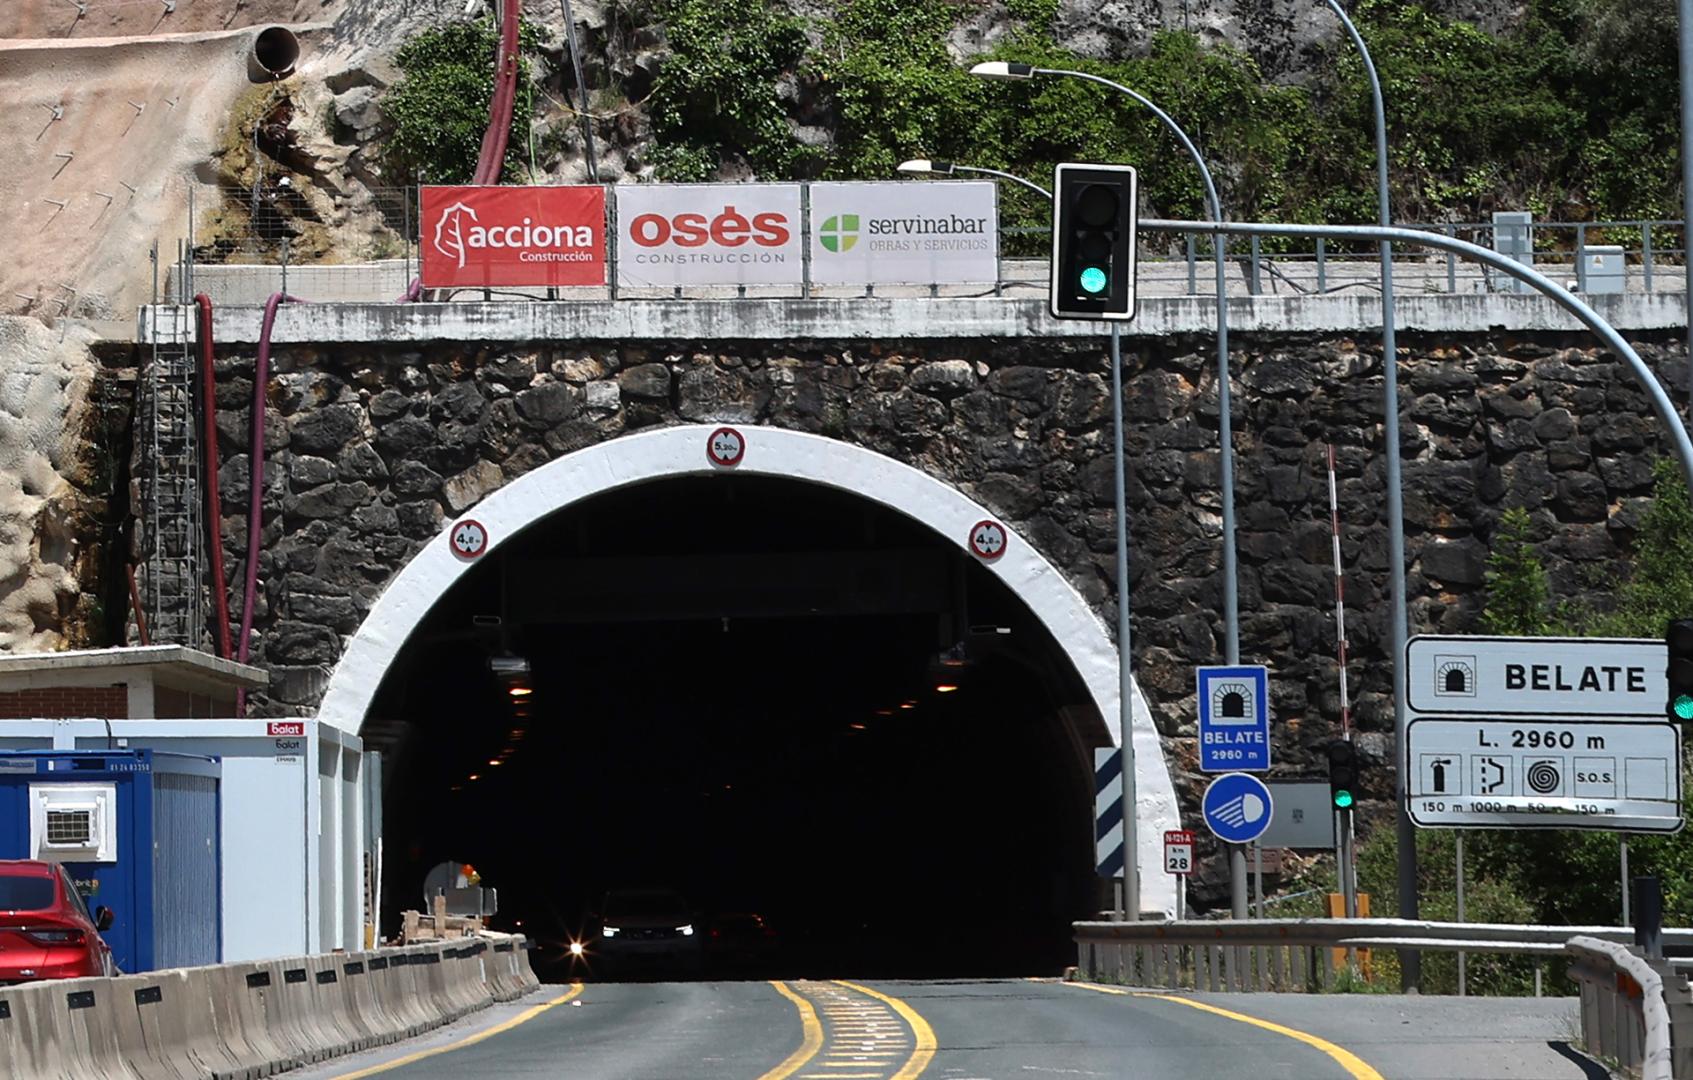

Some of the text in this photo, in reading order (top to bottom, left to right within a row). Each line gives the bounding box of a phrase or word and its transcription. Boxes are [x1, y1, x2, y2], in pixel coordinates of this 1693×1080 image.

[868, 214, 987, 235] servinabar
[467, 217, 593, 248] acciona
[869, 239, 988, 251] OBRAS Y SERVICIOS
[519, 251, 593, 262] Construcción
[635, 252, 785, 264] CONSTRUCCIÓN
[1505, 663, 1646, 693] BELATE
[1204, 731, 1264, 744] BELATE
[1478, 729, 1605, 749] L. 2960 m
[1211, 750, 1243, 760] 2960
[1577, 772, 1614, 783] S.O.S.
[1422, 802, 1463, 812] 150 m
[1470, 802, 1501, 812] 1000
[1575, 803, 1598, 815] 150
[1169, 857, 1188, 870] 28
